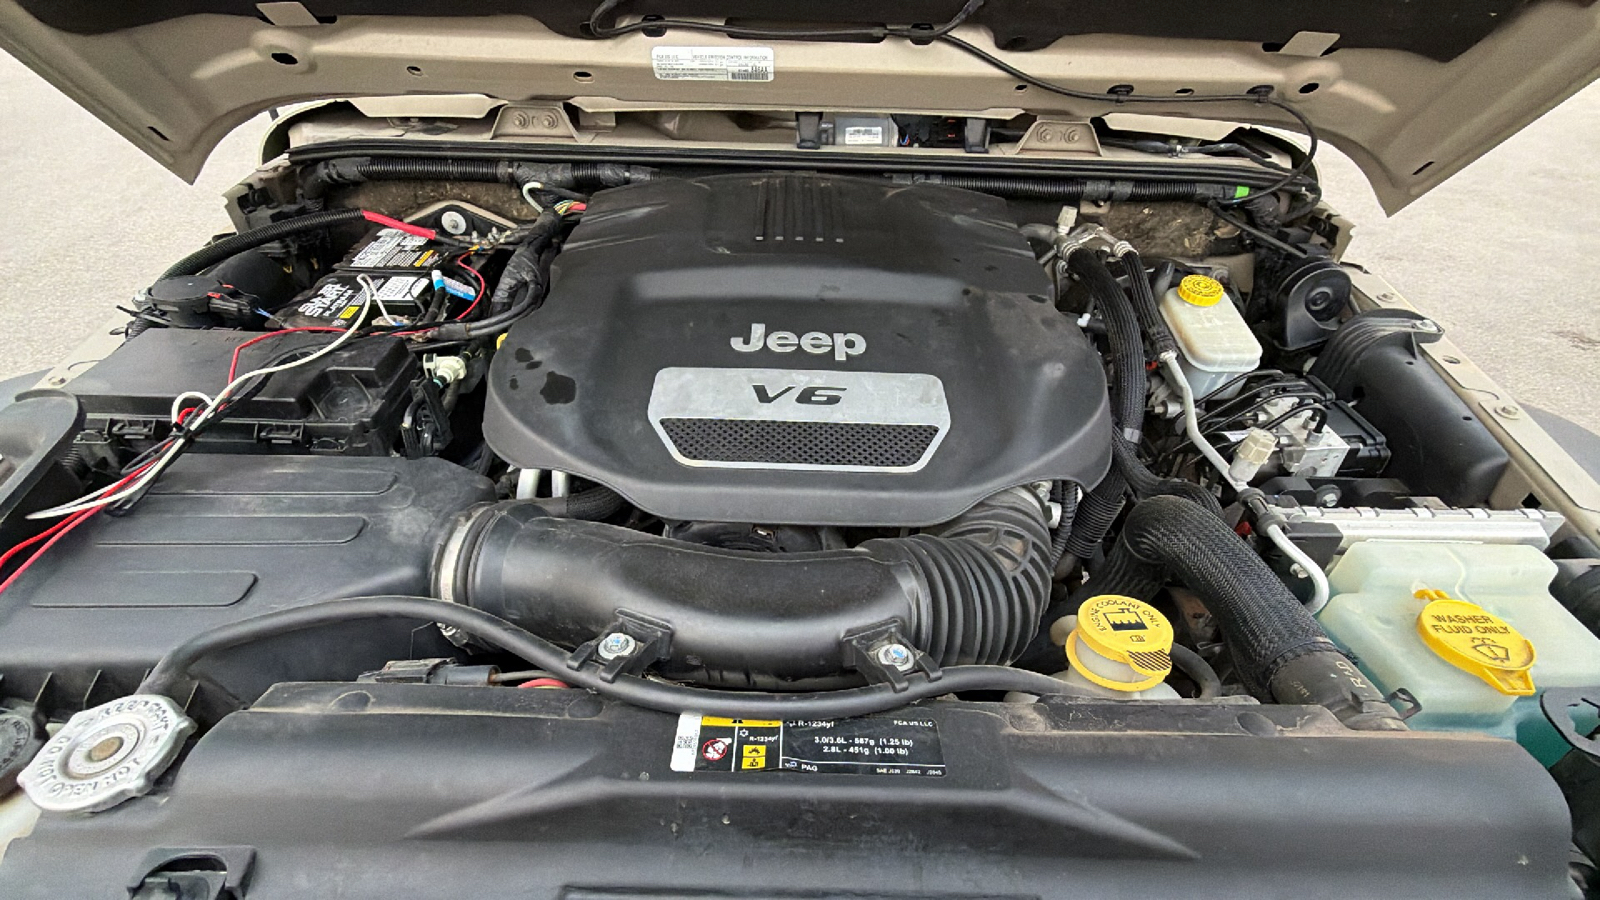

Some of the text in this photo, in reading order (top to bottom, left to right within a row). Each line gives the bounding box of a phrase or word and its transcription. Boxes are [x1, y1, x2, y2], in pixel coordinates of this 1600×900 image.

[730, 323, 867, 361] Jeep
[752, 384, 847, 405] V6
[1089, 599, 1161, 631] ENGINE COOLANT ONLY
[1431, 614, 1494, 624] WASHER
[1431, 624, 1511, 634] FLUID ONLY
[798, 720, 834, 729] R-1234yf
[749, 734, 779, 743] R-1234yf
[879, 737, 900, 747] (1.25
[901, 738, 914, 747] lb)
[822, 745, 842, 753] 2.8L
[874, 746, 895, 756] (1.00
[896, 747, 909, 756] lb)
[801, 763, 818, 772] PAG
